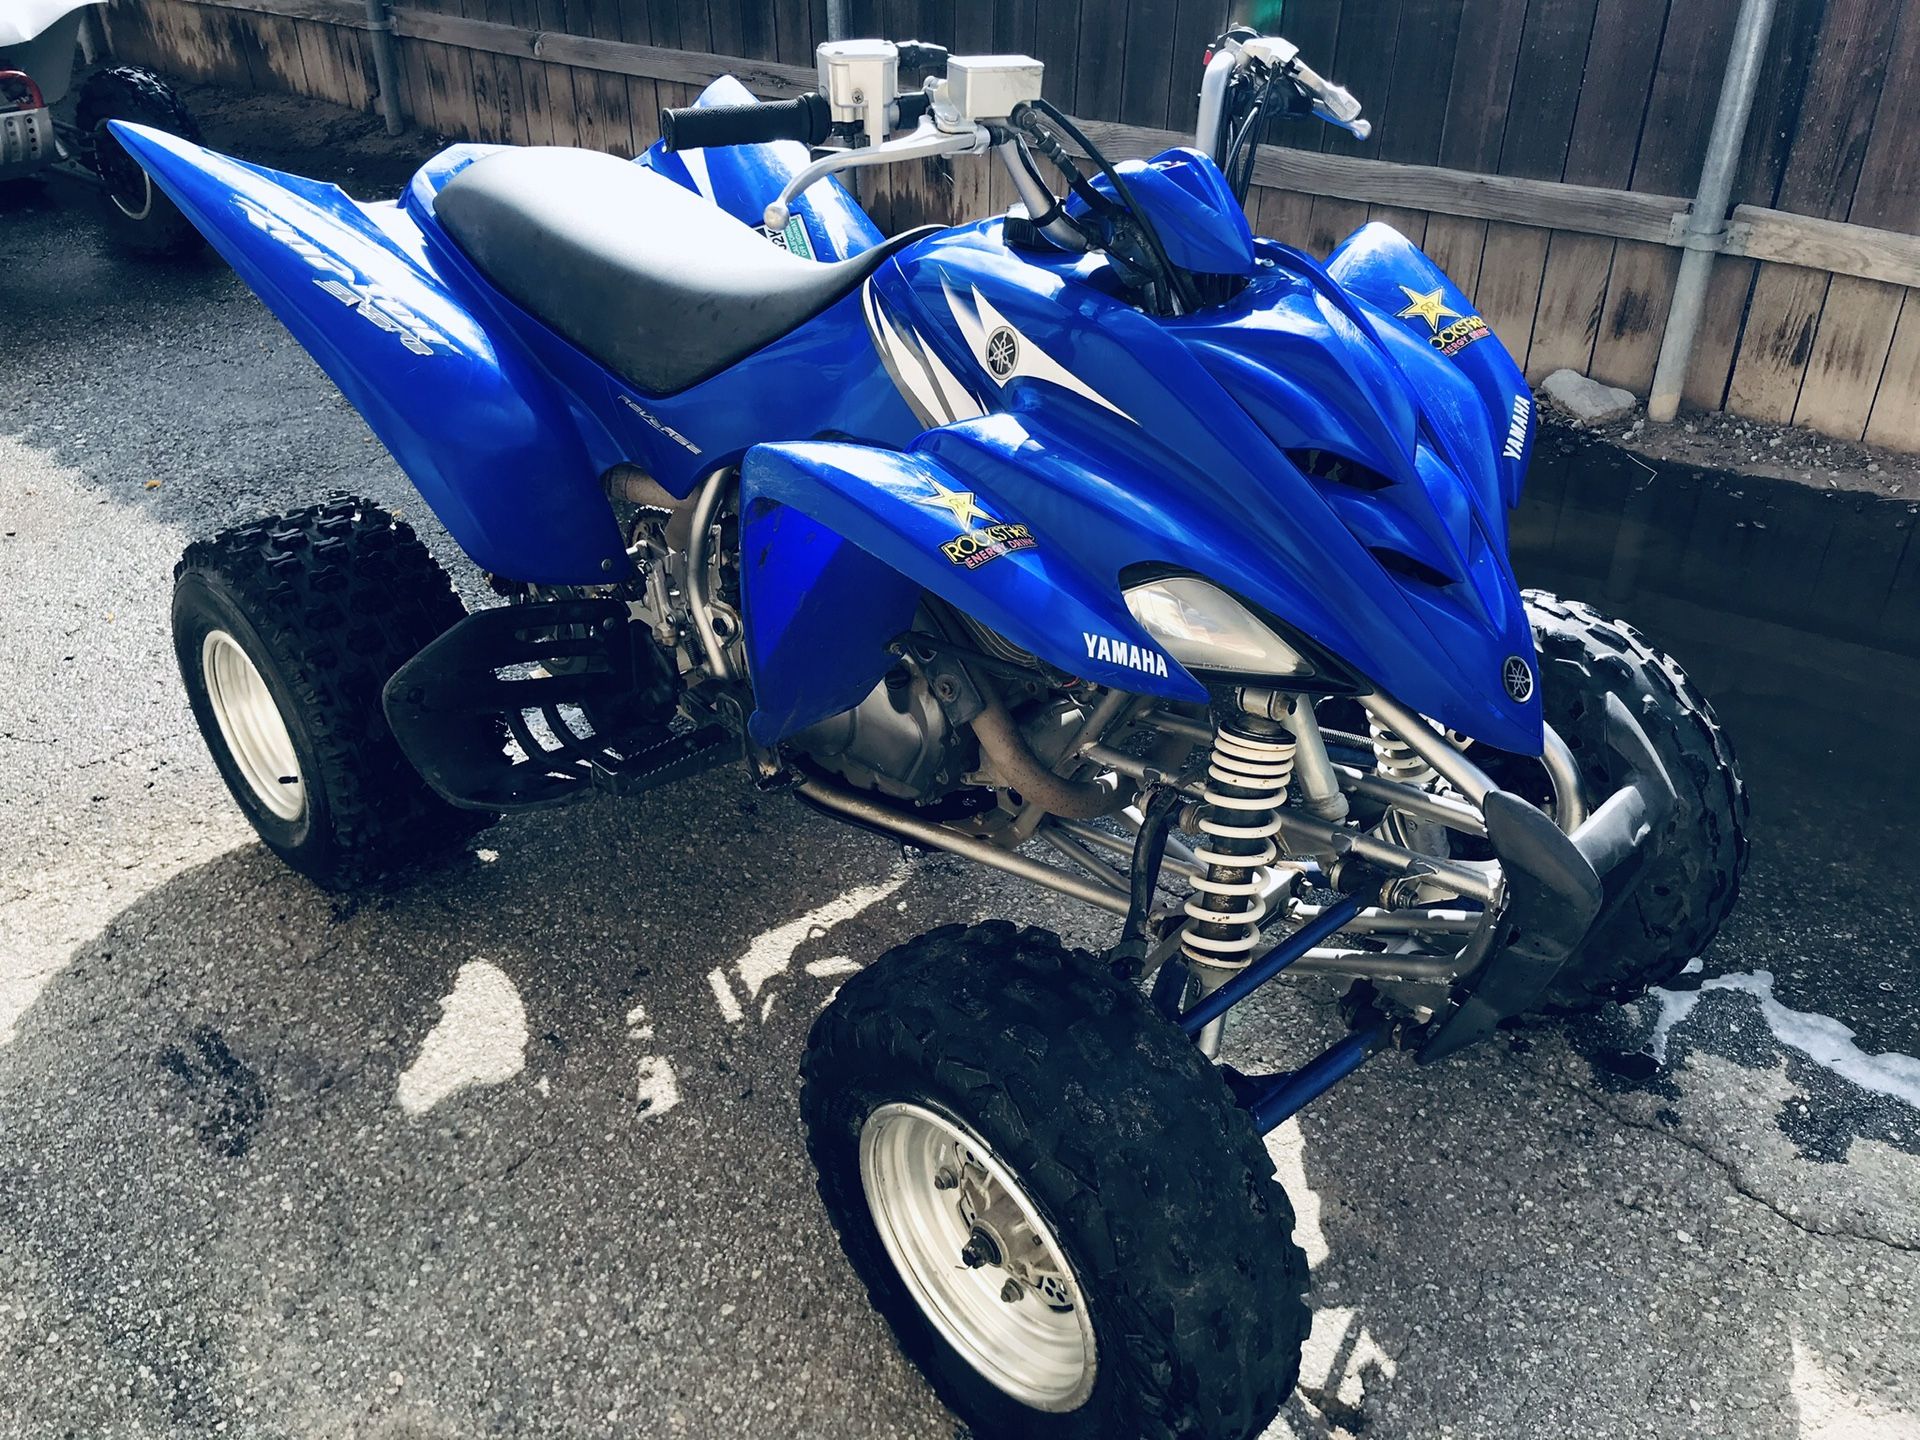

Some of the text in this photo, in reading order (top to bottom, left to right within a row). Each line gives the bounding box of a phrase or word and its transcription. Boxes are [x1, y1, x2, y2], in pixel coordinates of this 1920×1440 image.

[312, 279, 434, 356] 350
[1429, 315, 1486, 350] OCKSTAR
[1441, 336, 1469, 356] NERGY
[617, 394, 702, 455] REVERSE
[1502, 395, 1531, 461] YAMAHA
[965, 537, 1035, 567] ENERGY DRINK
[1083, 632, 1168, 678] YAMAHA
